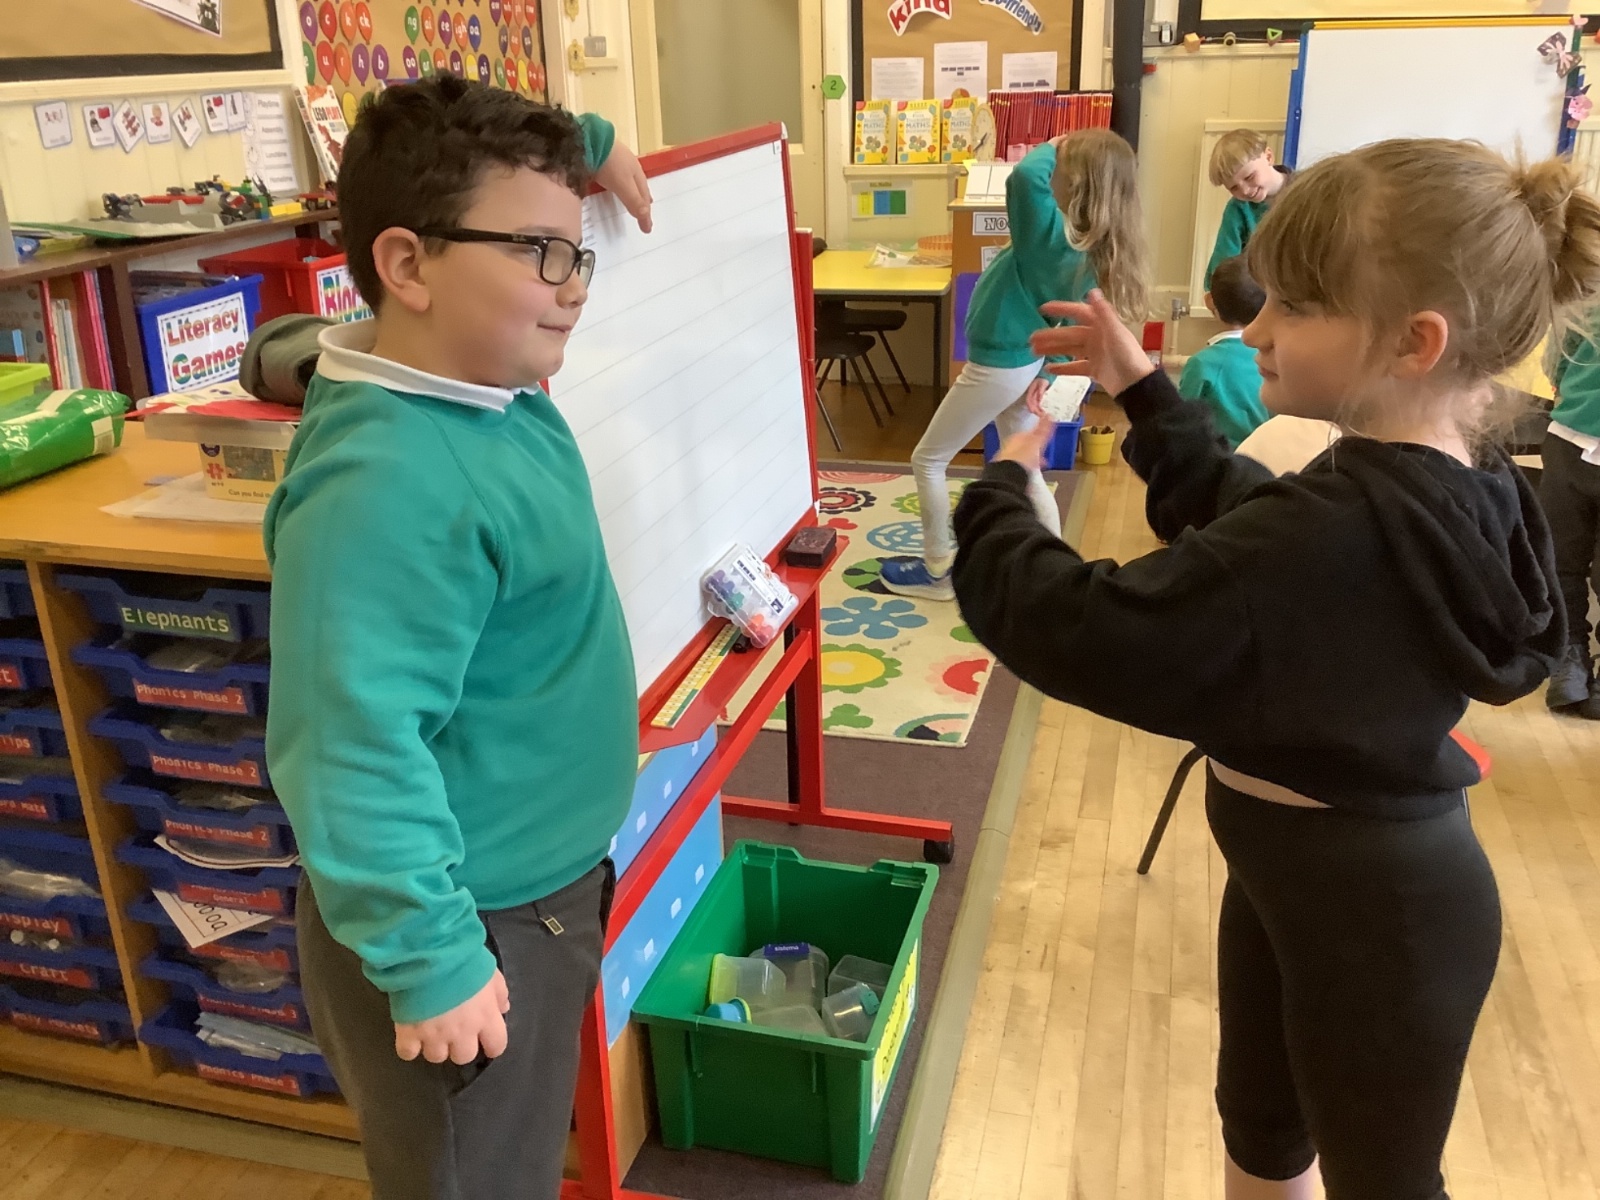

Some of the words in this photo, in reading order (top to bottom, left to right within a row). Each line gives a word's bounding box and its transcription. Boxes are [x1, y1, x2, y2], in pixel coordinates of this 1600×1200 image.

[324, 14, 331, 25] c
[345, 12, 352, 27] k
[359, 12, 371, 28] ck
[407, 16, 418, 31] ng
[980, 0, 1042, 32] o-friendly
[440, 21, 450, 32] ee
[455, 23, 467, 39] igh
[469, 25, 480, 36] oa
[358, 54, 365, 69] h
[377, 55, 385, 70] b
[405, 60, 416, 68] oo
[830, 79, 837, 91] 2
[166, 307, 240, 347] Literacy
[172, 341, 246, 385] Games
[122, 607, 229, 634] Elephants
[136, 684, 187, 699] Phonics
[193, 690, 229, 704] Phase
[236, 694, 243, 705] 2
[152, 755, 202, 770] Phonics
[208, 763, 243, 776] Phase
[250, 766, 257, 778] 2
[260, 830, 268, 841] 2
[0, 913, 59, 933] isplay
